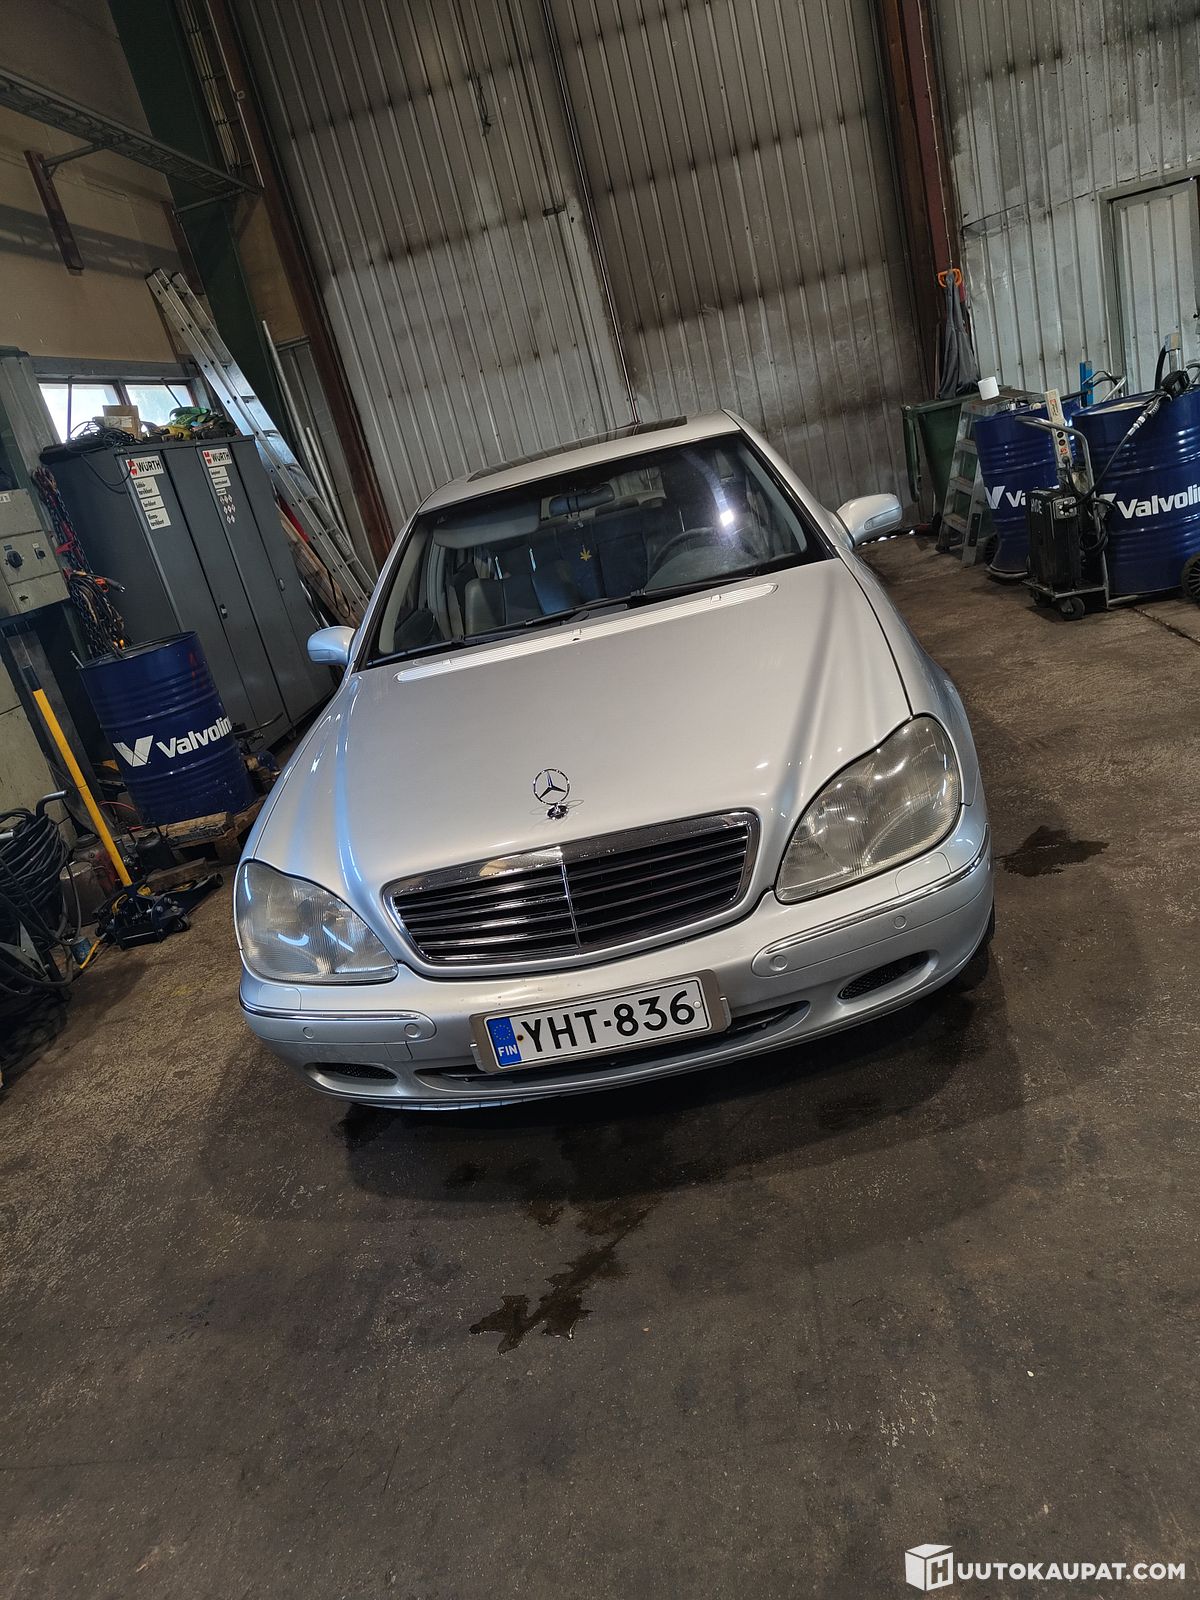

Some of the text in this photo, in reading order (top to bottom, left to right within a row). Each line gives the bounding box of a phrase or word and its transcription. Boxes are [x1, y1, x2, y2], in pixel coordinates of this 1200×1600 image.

[136, 460, 161, 473] WÜRTH
[521, 990, 695, 1052] YHT-836
[497, 1044, 518, 1057] FIN
